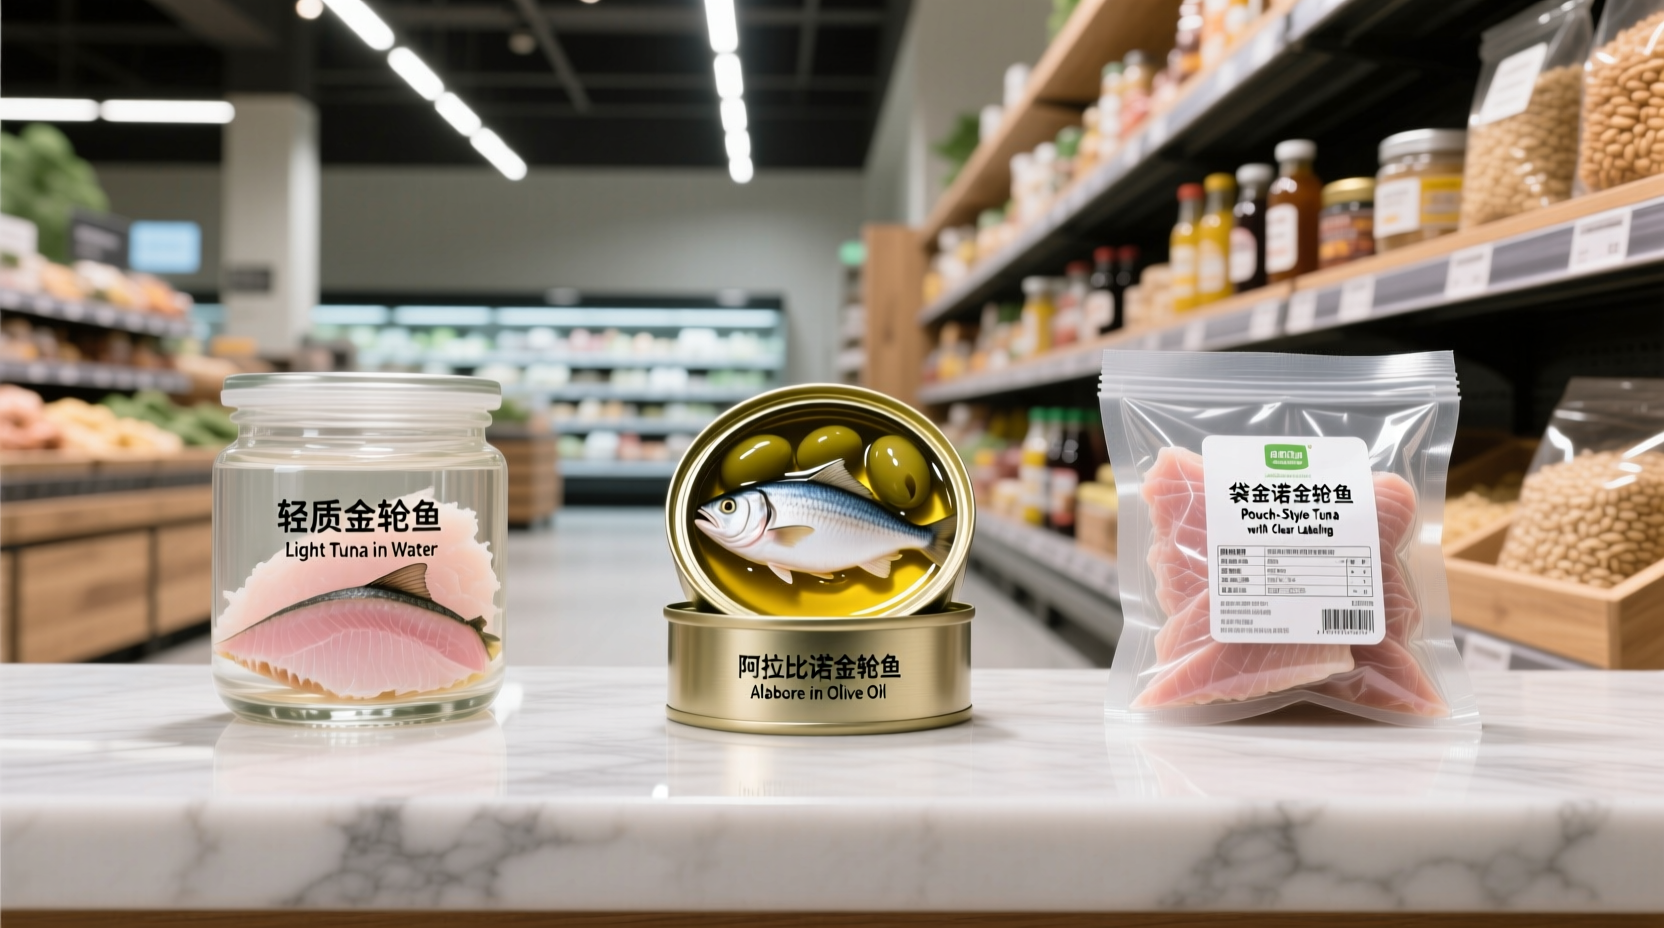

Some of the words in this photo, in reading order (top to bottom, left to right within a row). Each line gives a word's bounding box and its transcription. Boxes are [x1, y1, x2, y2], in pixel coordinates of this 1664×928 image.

[1312, 508, 1340, 521] Tuna
[1272, 523, 1295, 535] Clear
[285, 541, 326, 562] Light
[329, 542, 368, 558] Tuna
[373, 541, 388, 558] in
[391, 541, 439, 558] Water
[750, 683, 806, 700] Alabore
[809, 686, 823, 701] in
[826, 684, 864, 701] Olive
